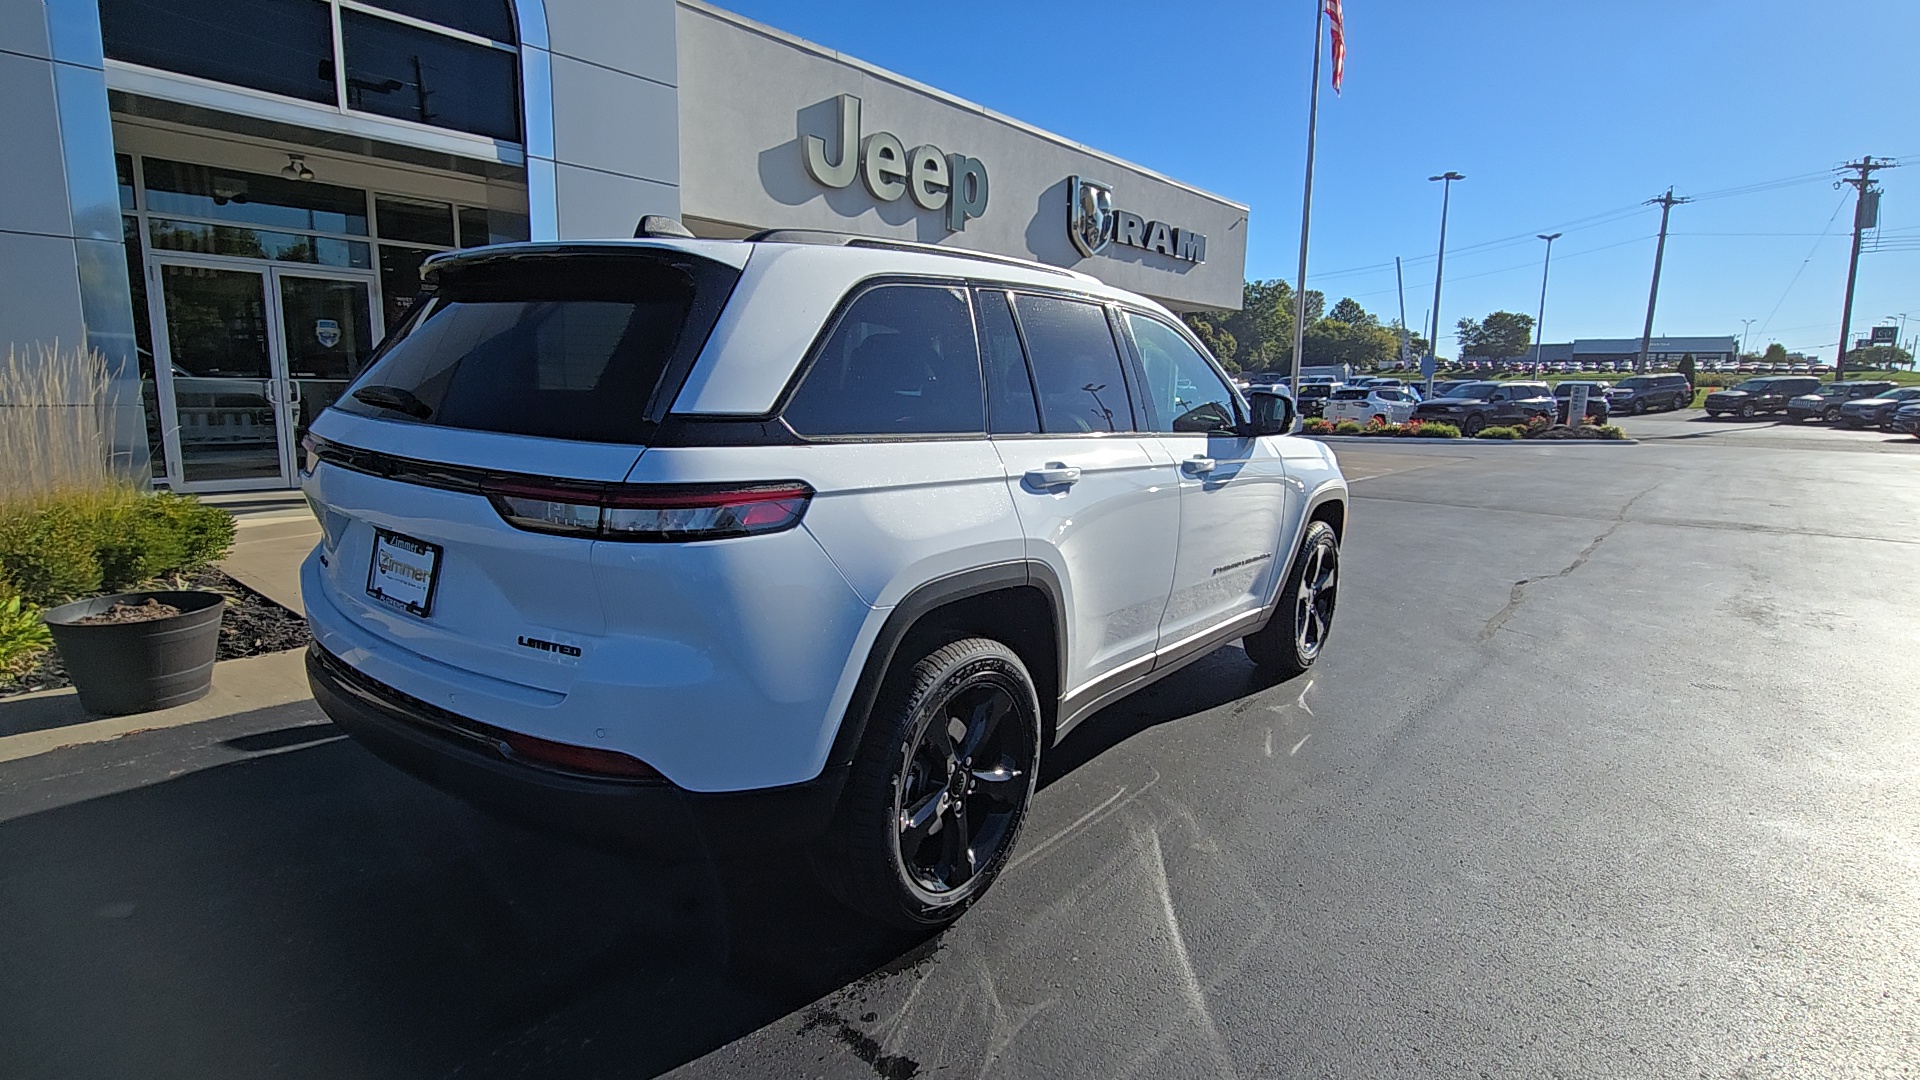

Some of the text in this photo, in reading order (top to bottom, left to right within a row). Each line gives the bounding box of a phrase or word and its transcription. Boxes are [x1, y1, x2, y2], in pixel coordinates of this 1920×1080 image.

[801, 93, 989, 232] Jeep
[1111, 209, 1207, 264] RAM
[389, 535, 419, 553] Zimmer
[379, 549, 431, 584] Zimmer
[517, 635, 582, 657] LIMITED
